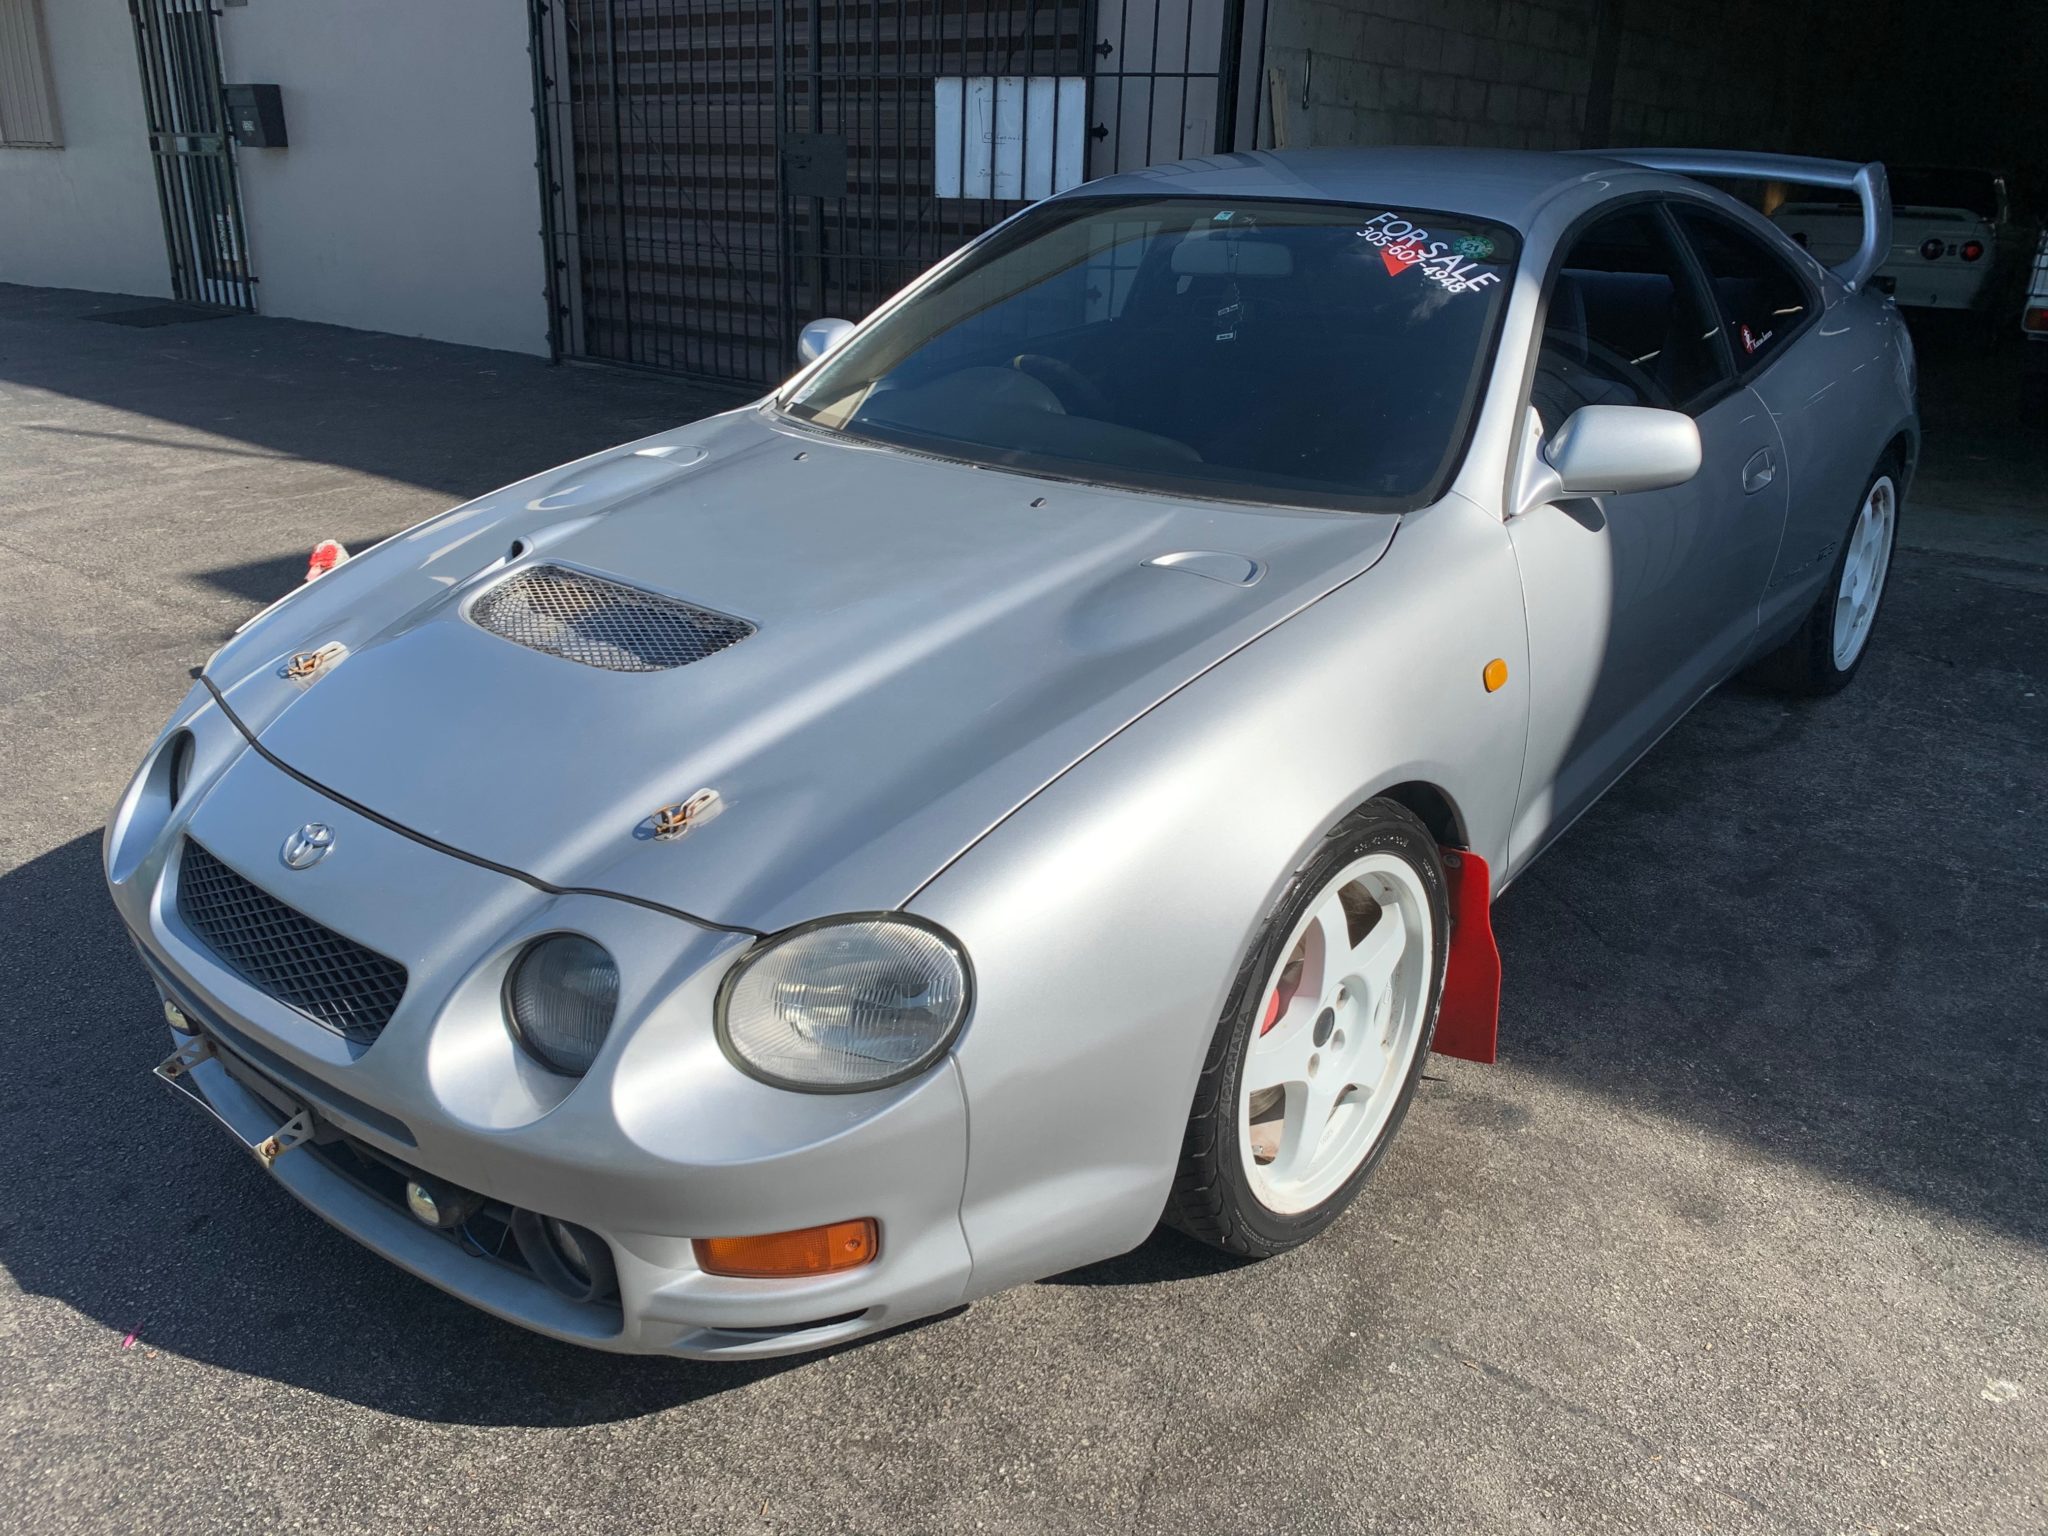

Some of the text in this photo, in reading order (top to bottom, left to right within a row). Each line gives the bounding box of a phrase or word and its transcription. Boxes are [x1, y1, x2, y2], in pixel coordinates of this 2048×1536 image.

[1356, 226, 1468, 293] 305-607-4948
[1365, 211, 1429, 248] FOR
[1418, 241, 1501, 292] SALE
[1465, 243, 1480, 251] 21
